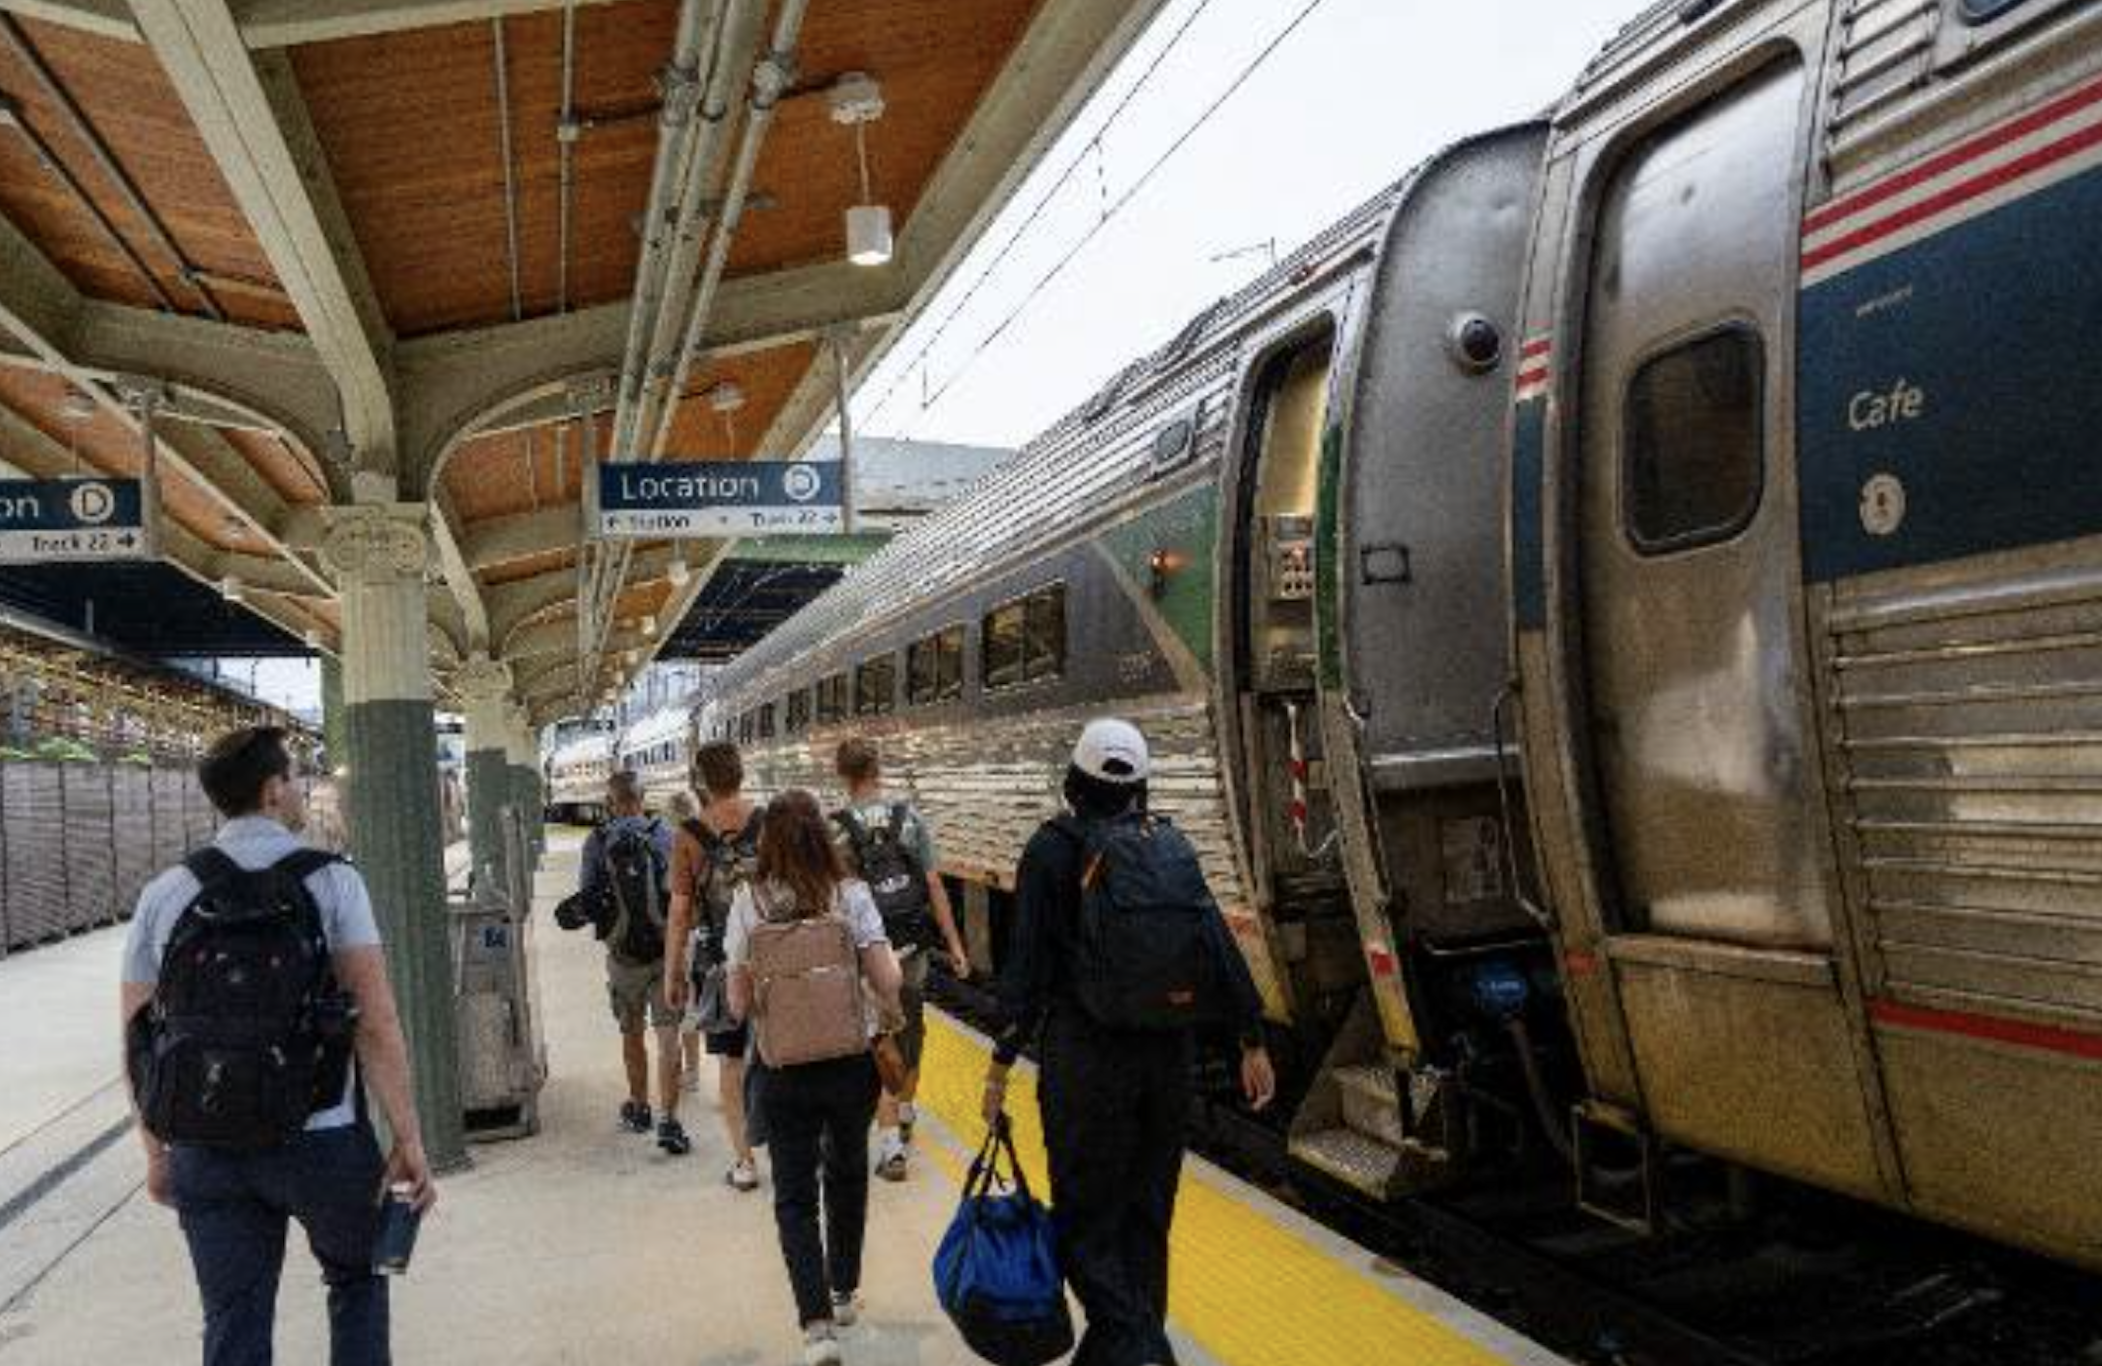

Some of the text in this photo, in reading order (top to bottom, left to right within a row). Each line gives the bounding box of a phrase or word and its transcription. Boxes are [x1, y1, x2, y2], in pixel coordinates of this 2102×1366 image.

[1849, 377, 1924, 431] Cafe
[621, 471, 759, 500] Location
[79, 487, 110, 519] D
[32, 532, 80, 551] Track
